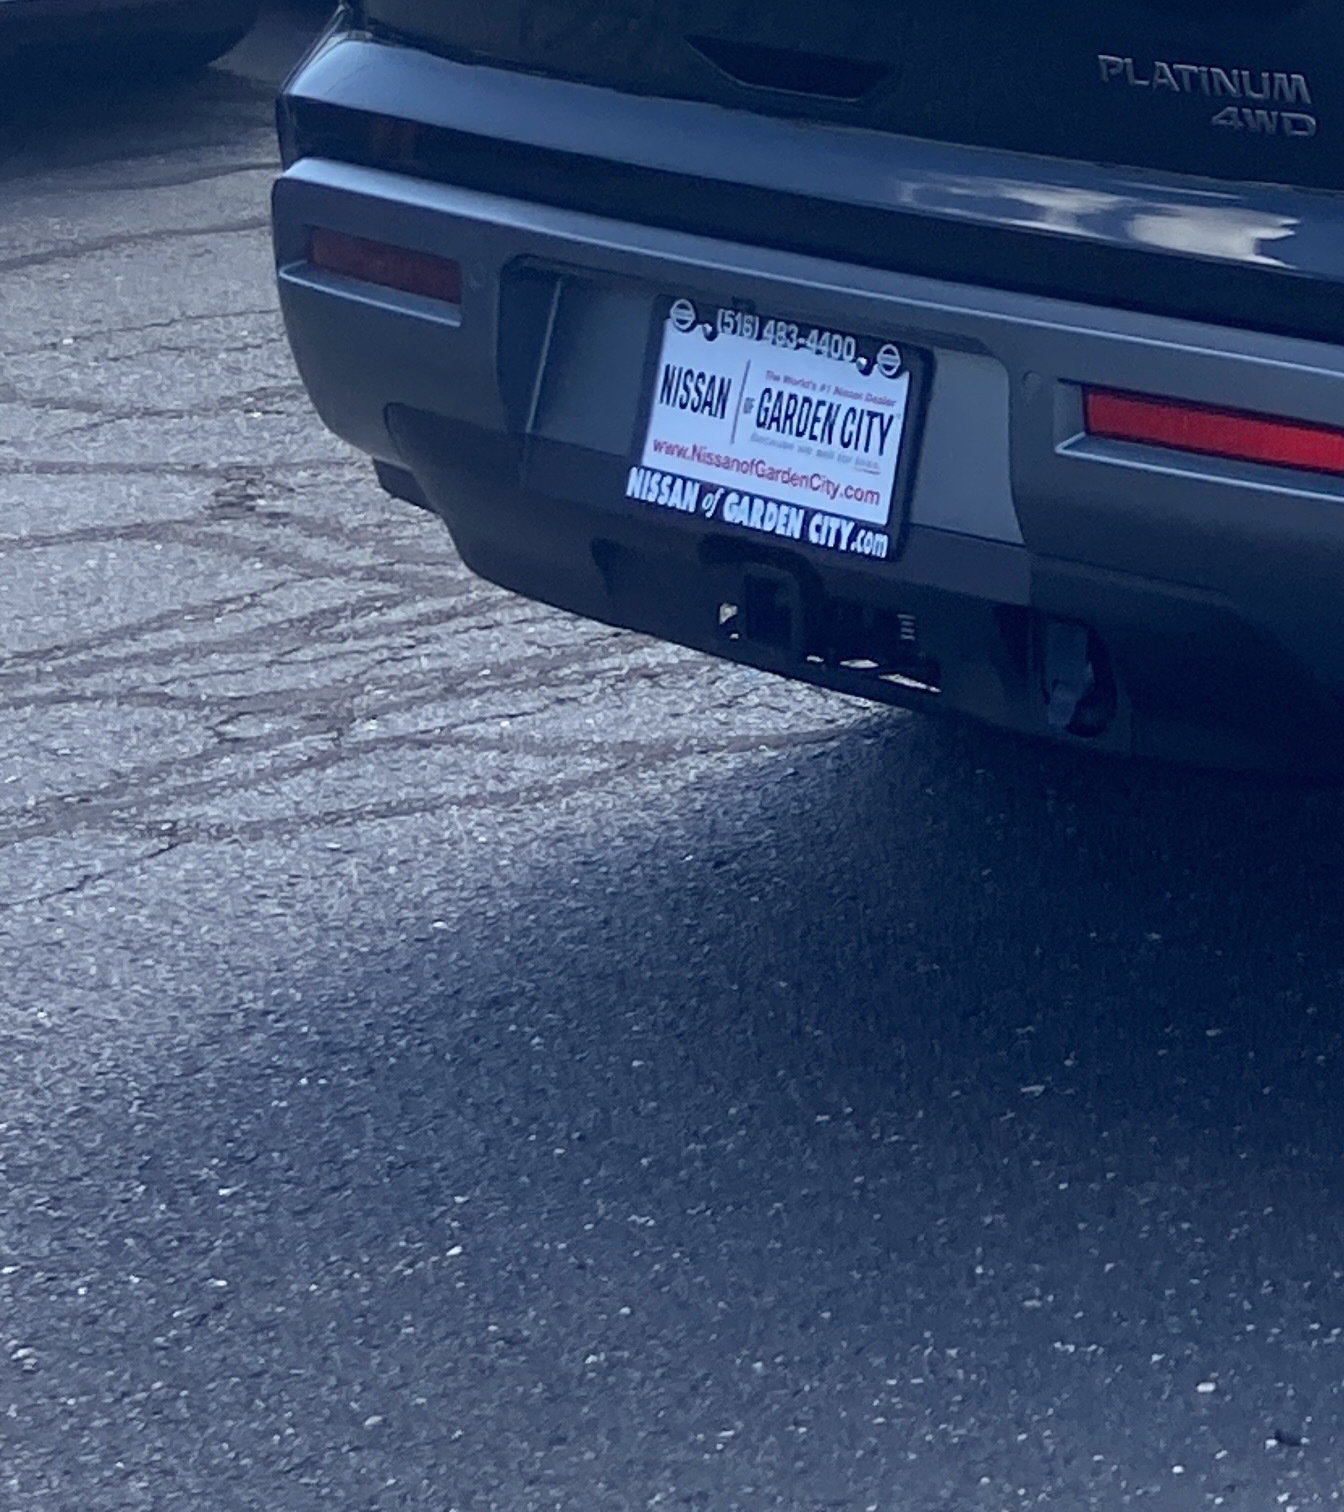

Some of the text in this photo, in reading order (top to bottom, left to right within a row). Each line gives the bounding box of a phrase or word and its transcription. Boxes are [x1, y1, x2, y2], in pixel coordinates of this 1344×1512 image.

[1097, 54, 1312, 105] PLATINUM
[1210, 106, 1317, 137] 4WD
[659, 363, 732, 420] NISSAN
[756, 387, 842, 445] GARDEN
[840, 406, 894, 456] CITY
[653, 439, 881, 506] www.NissanofGardenCity.com
[626, 466, 889, 558] NISSAN of GARDEN CITY.com
